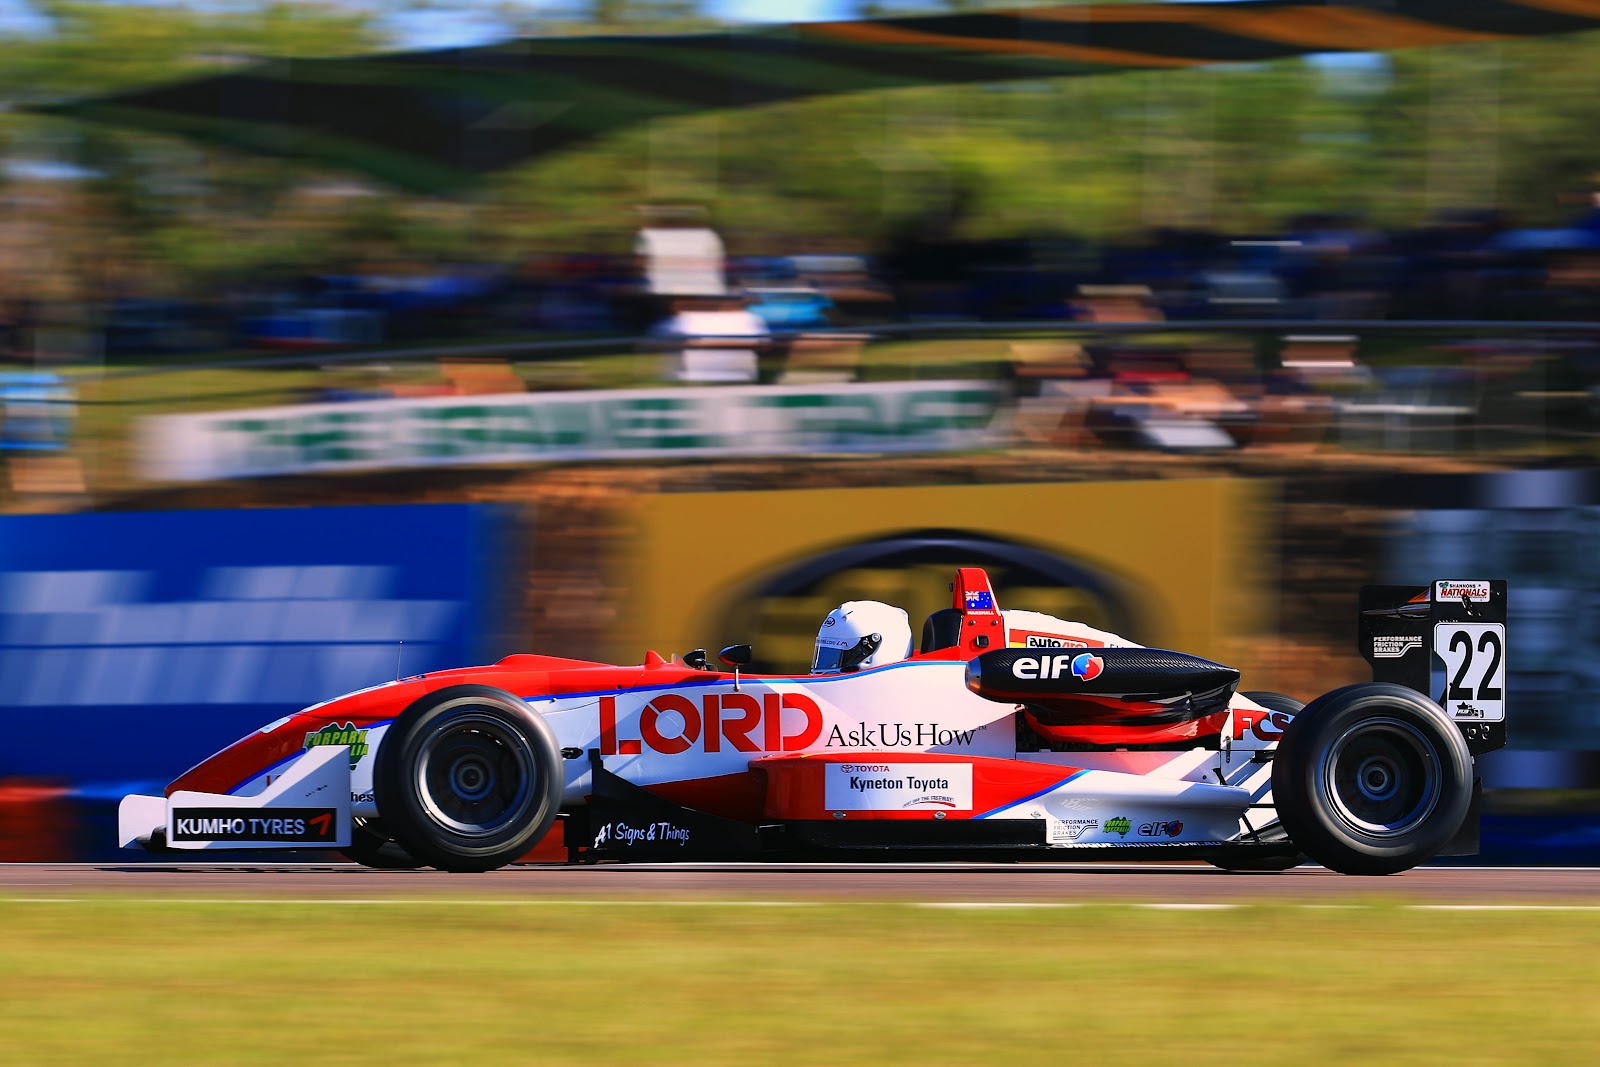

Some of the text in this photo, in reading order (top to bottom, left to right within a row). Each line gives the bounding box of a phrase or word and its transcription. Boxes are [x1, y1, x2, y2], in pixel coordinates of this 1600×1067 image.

[1441, 588, 1487, 597] NATIONALS
[1012, 655, 1070, 680] elf
[1448, 630, 1502, 700] 22
[599, 692, 824, 755] LORD
[824, 721, 877, 747] Ask
[878, 723, 912, 747] Us
[914, 723, 976, 746] How
[1233, 709, 1291, 741] FCS
[305, 730, 368, 746] FORPARK
[850, 776, 948, 792] Kyneton Toyota
[176, 818, 306, 835] KUMHO TYRES
[614, 822, 646, 846] Signs
[646, 823, 656, 841] &
[657, 822, 690, 846] Things
[1137, 822, 1168, 837] elf
